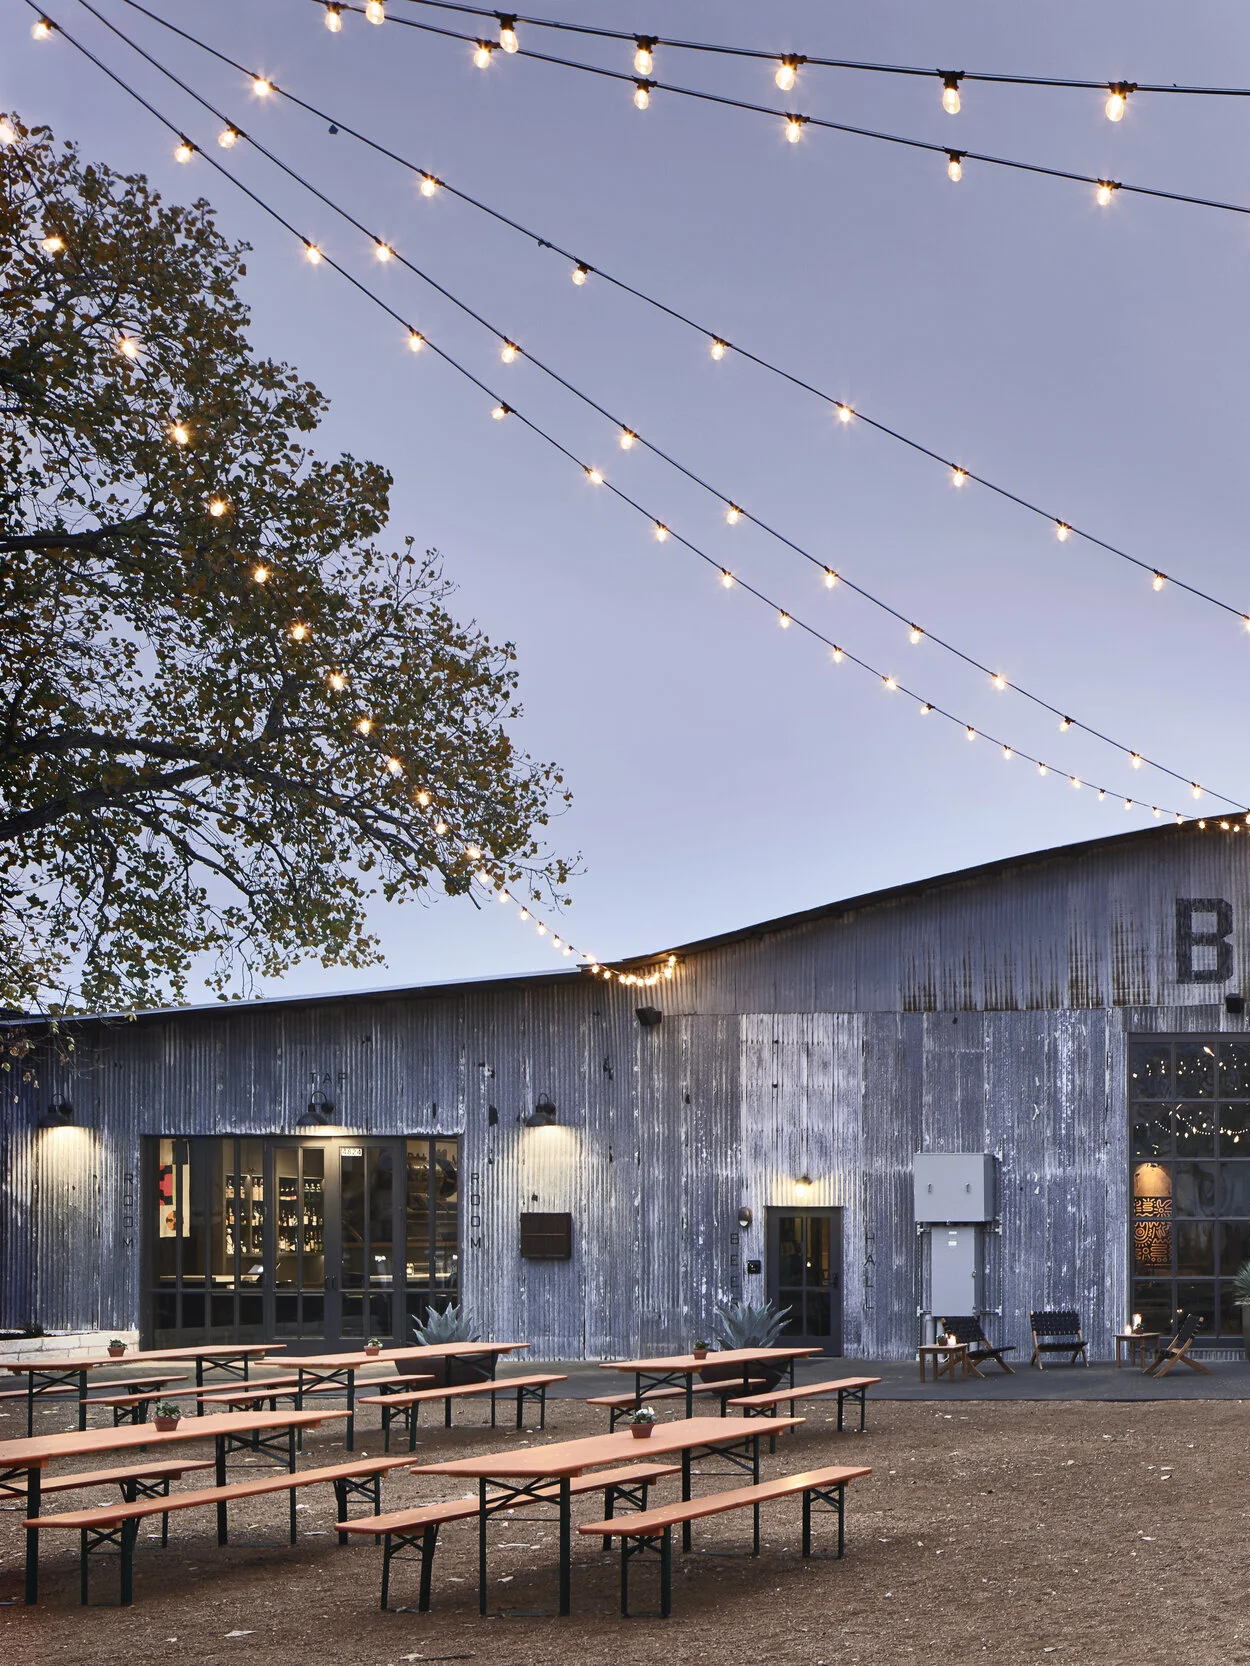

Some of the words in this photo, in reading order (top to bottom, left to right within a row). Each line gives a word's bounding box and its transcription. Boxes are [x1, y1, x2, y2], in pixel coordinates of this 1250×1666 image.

[123, 1173, 134, 1249] ROOM
[470, 1172, 481, 1249] ROOM
[864, 1233, 875, 1309] HALL
